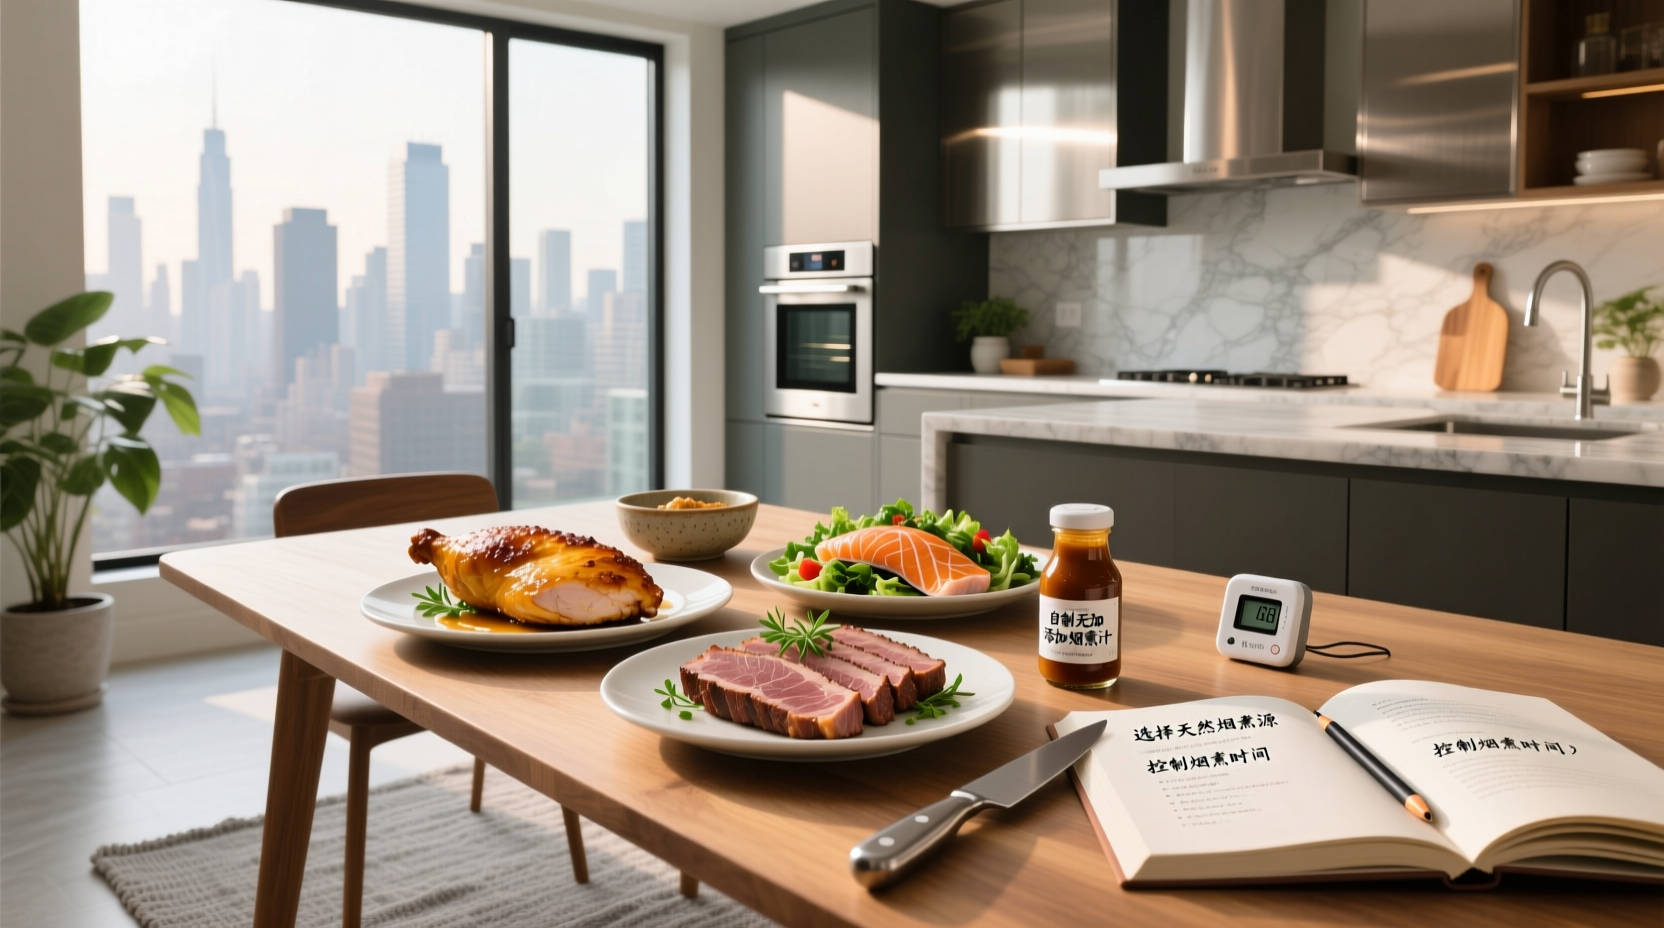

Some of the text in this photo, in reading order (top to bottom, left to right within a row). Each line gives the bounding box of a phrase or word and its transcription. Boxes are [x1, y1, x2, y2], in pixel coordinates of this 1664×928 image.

[1147, 747, 1271, 774] 控制烟熏时间
